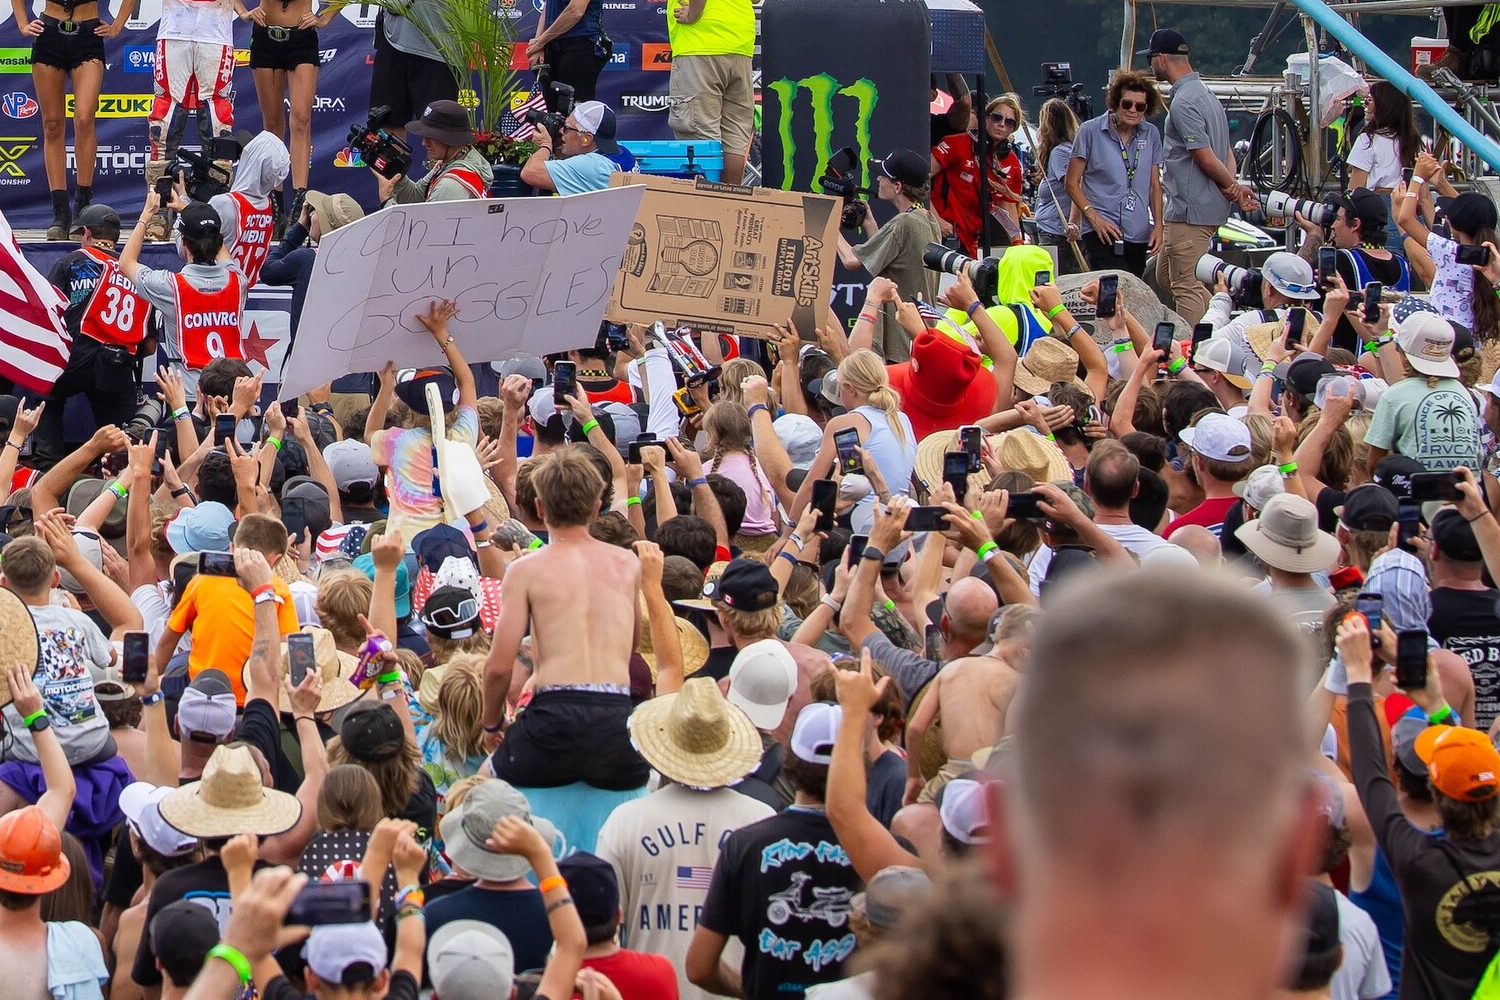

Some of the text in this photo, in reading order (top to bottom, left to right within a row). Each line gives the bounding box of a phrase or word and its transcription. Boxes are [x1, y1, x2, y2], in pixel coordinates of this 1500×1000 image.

[500, 211, 605, 246] have
[775, 238, 787, 295] DISPLAY BOARD
[782, 244, 796, 292] TRIFOLD
[796, 235, 823, 308] ArtSkills
[100, 286, 135, 332] 38
[184, 312, 238, 329] CONVRG
[326, 256, 617, 351] GOGGLES
[206, 331, 226, 358] 9
[1429, 444, 1476, 456] RVCA
[641, 823, 706, 857] GULF
[815, 840, 851, 866] FAS
